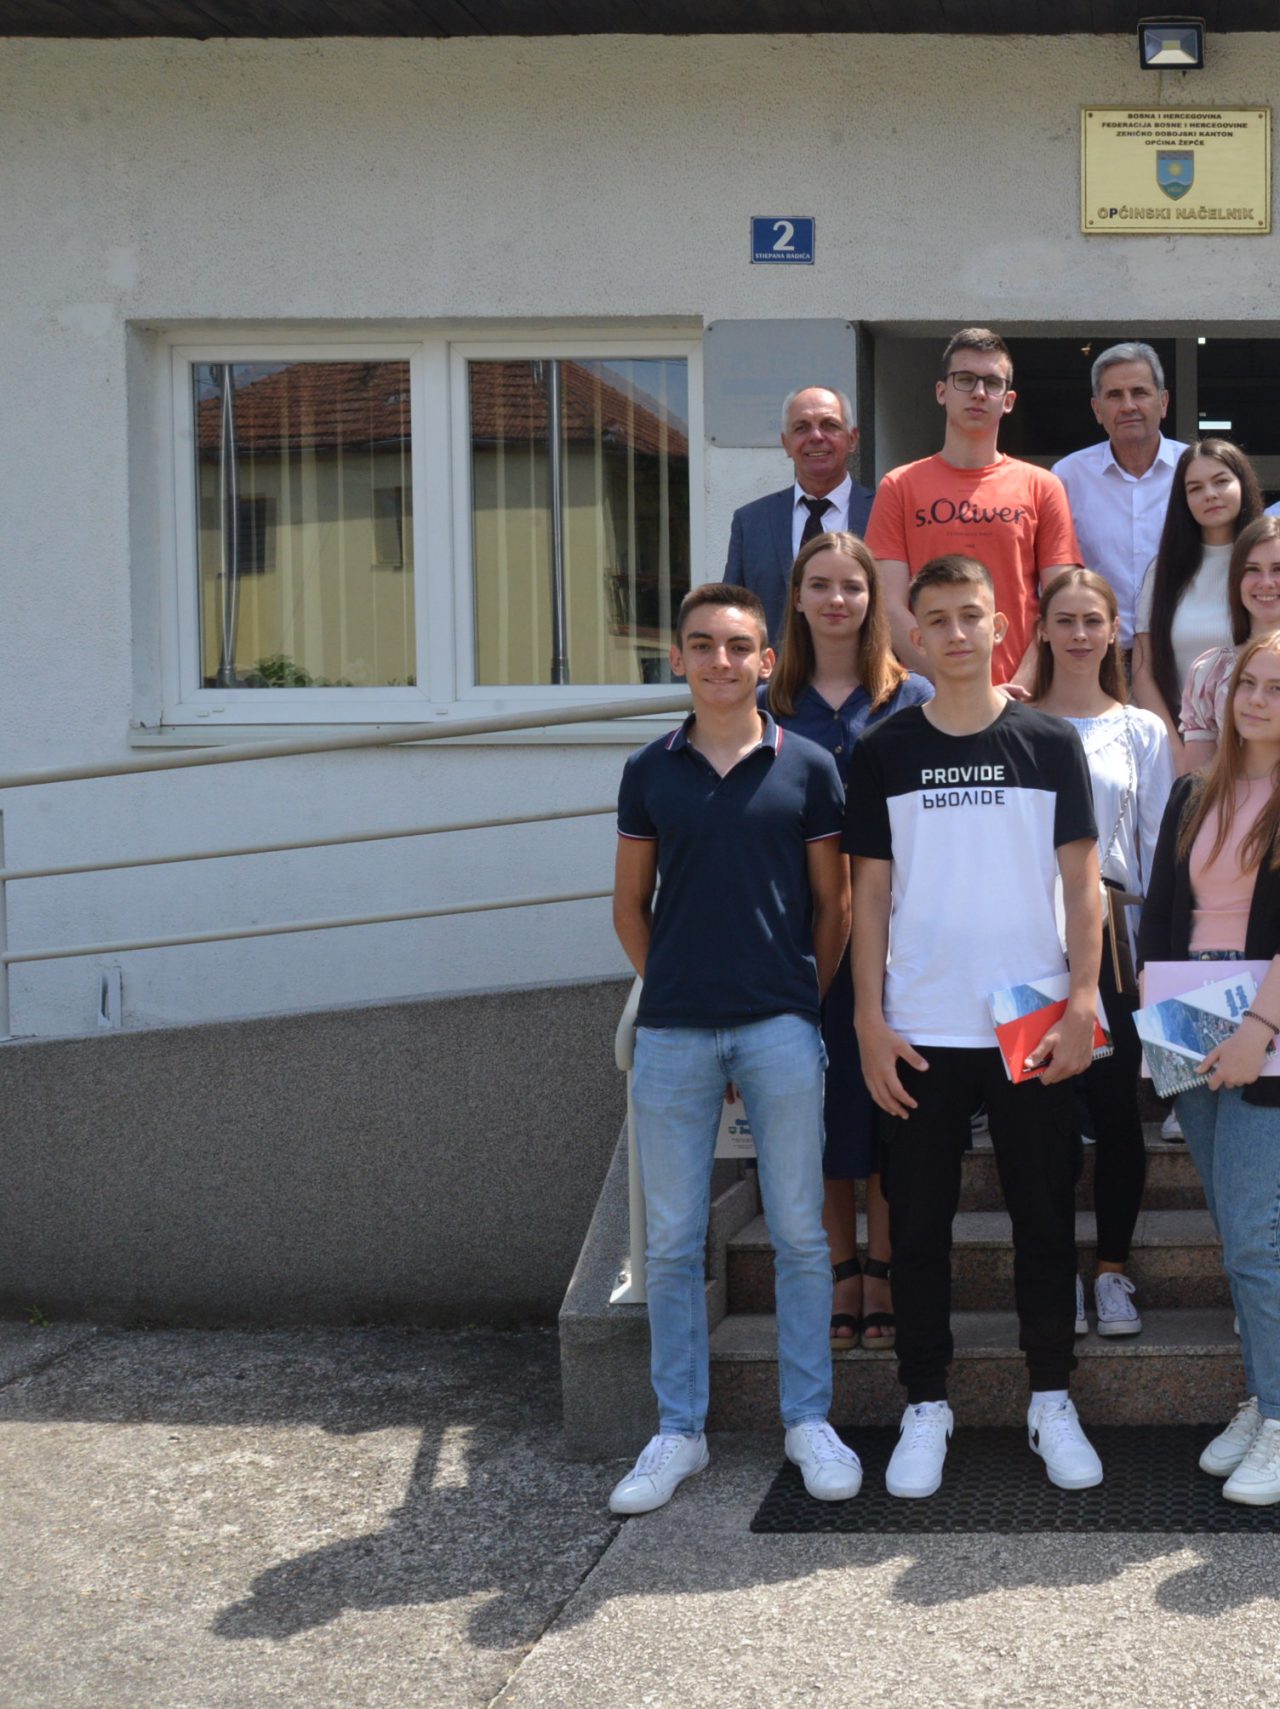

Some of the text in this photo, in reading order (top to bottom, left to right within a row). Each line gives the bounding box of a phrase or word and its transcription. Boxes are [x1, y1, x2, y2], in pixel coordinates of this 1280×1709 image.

[1178, 138, 1205, 146] ŽEPČE
[1097, 205, 1255, 220] OPĆINSKI NAČELNIK
[773, 220, 795, 251] 2
[916, 498, 1025, 527] s.Oliver
[921, 765, 1005, 784] PROVIDE
